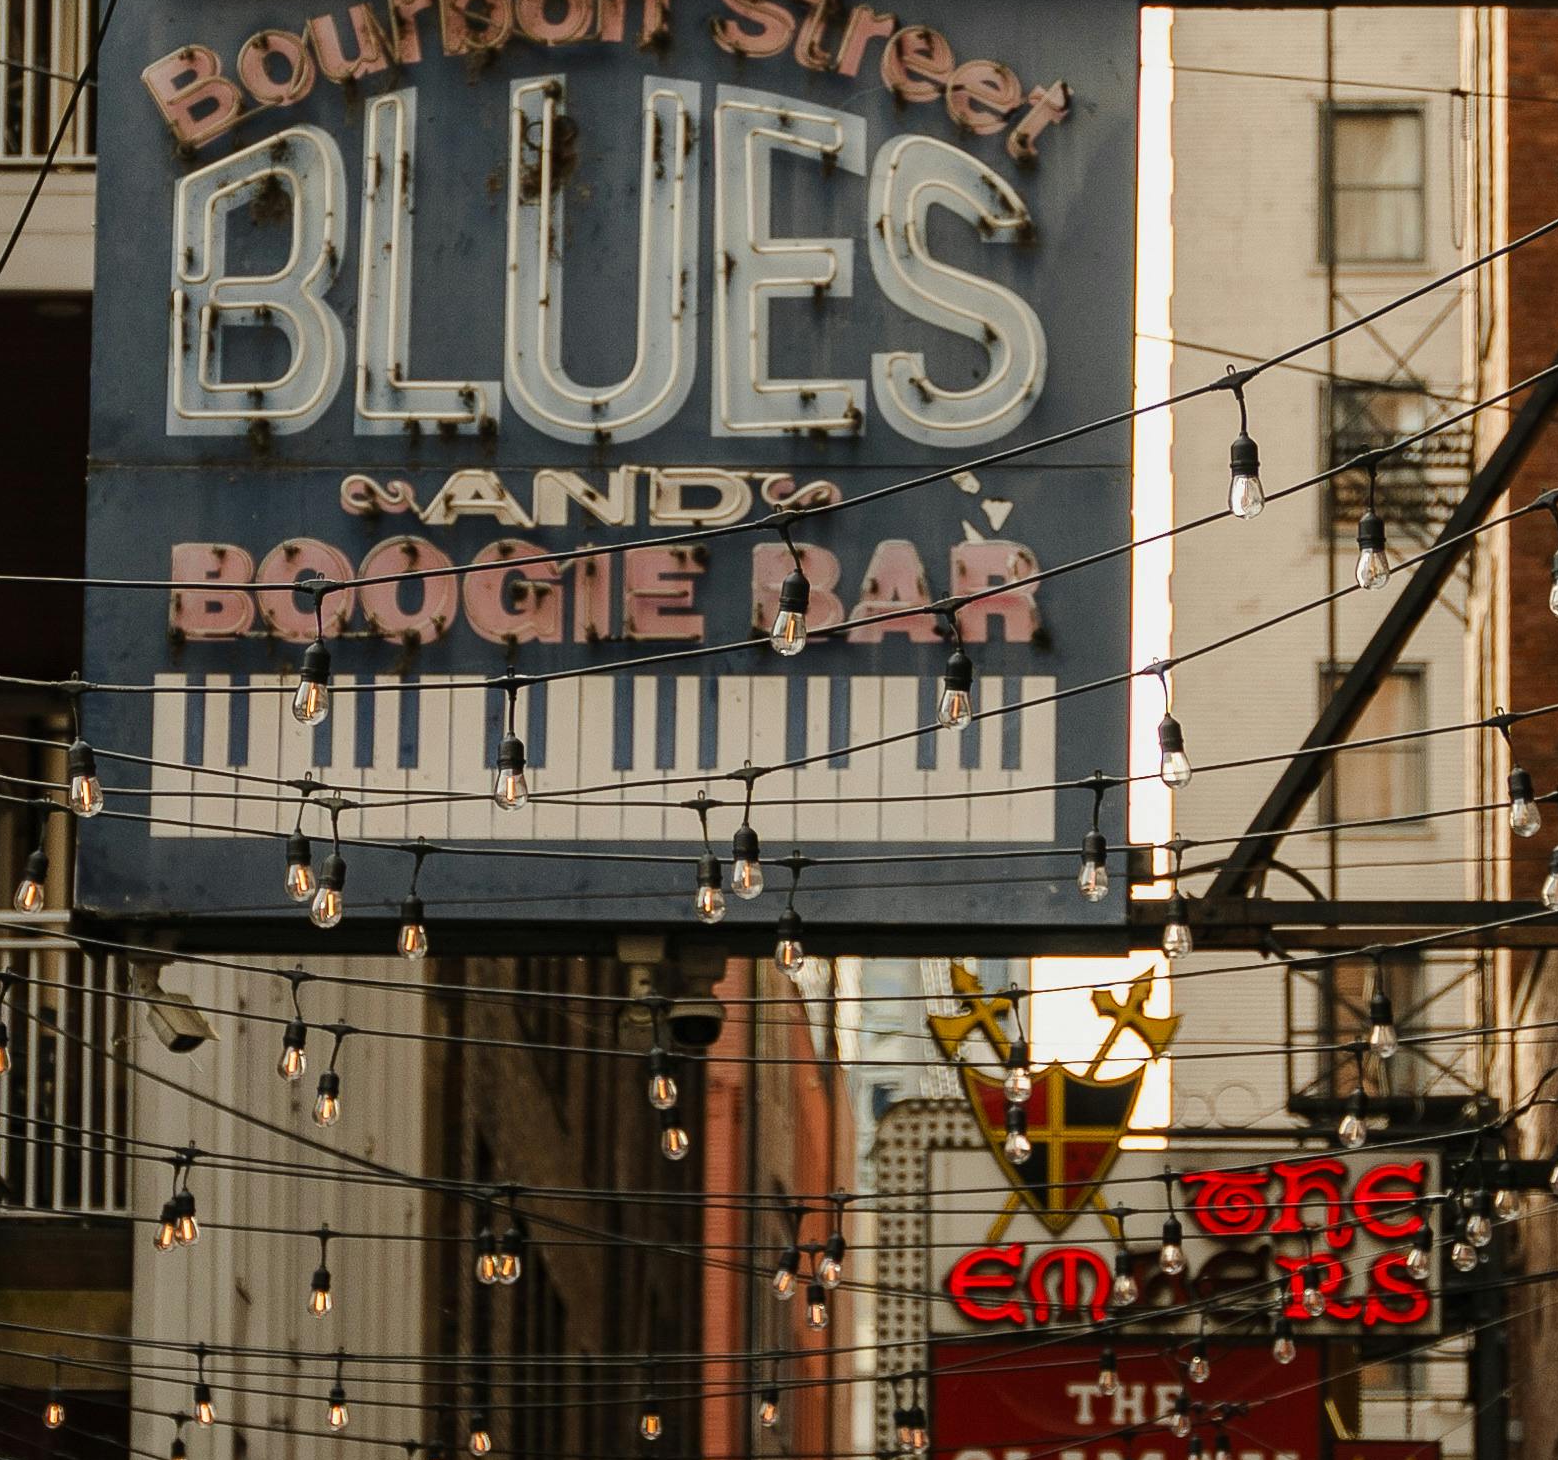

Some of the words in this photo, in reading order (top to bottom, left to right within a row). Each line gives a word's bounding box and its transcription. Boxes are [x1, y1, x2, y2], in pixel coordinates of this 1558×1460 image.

[167, 76, 1048, 448] BLUES
[417, 468, 755, 529] AND
[170, 535, 709, 646] BOOGIE
[751, 539, 1044, 646] BAR
[1065, 1383, 1188, 1427] THE
